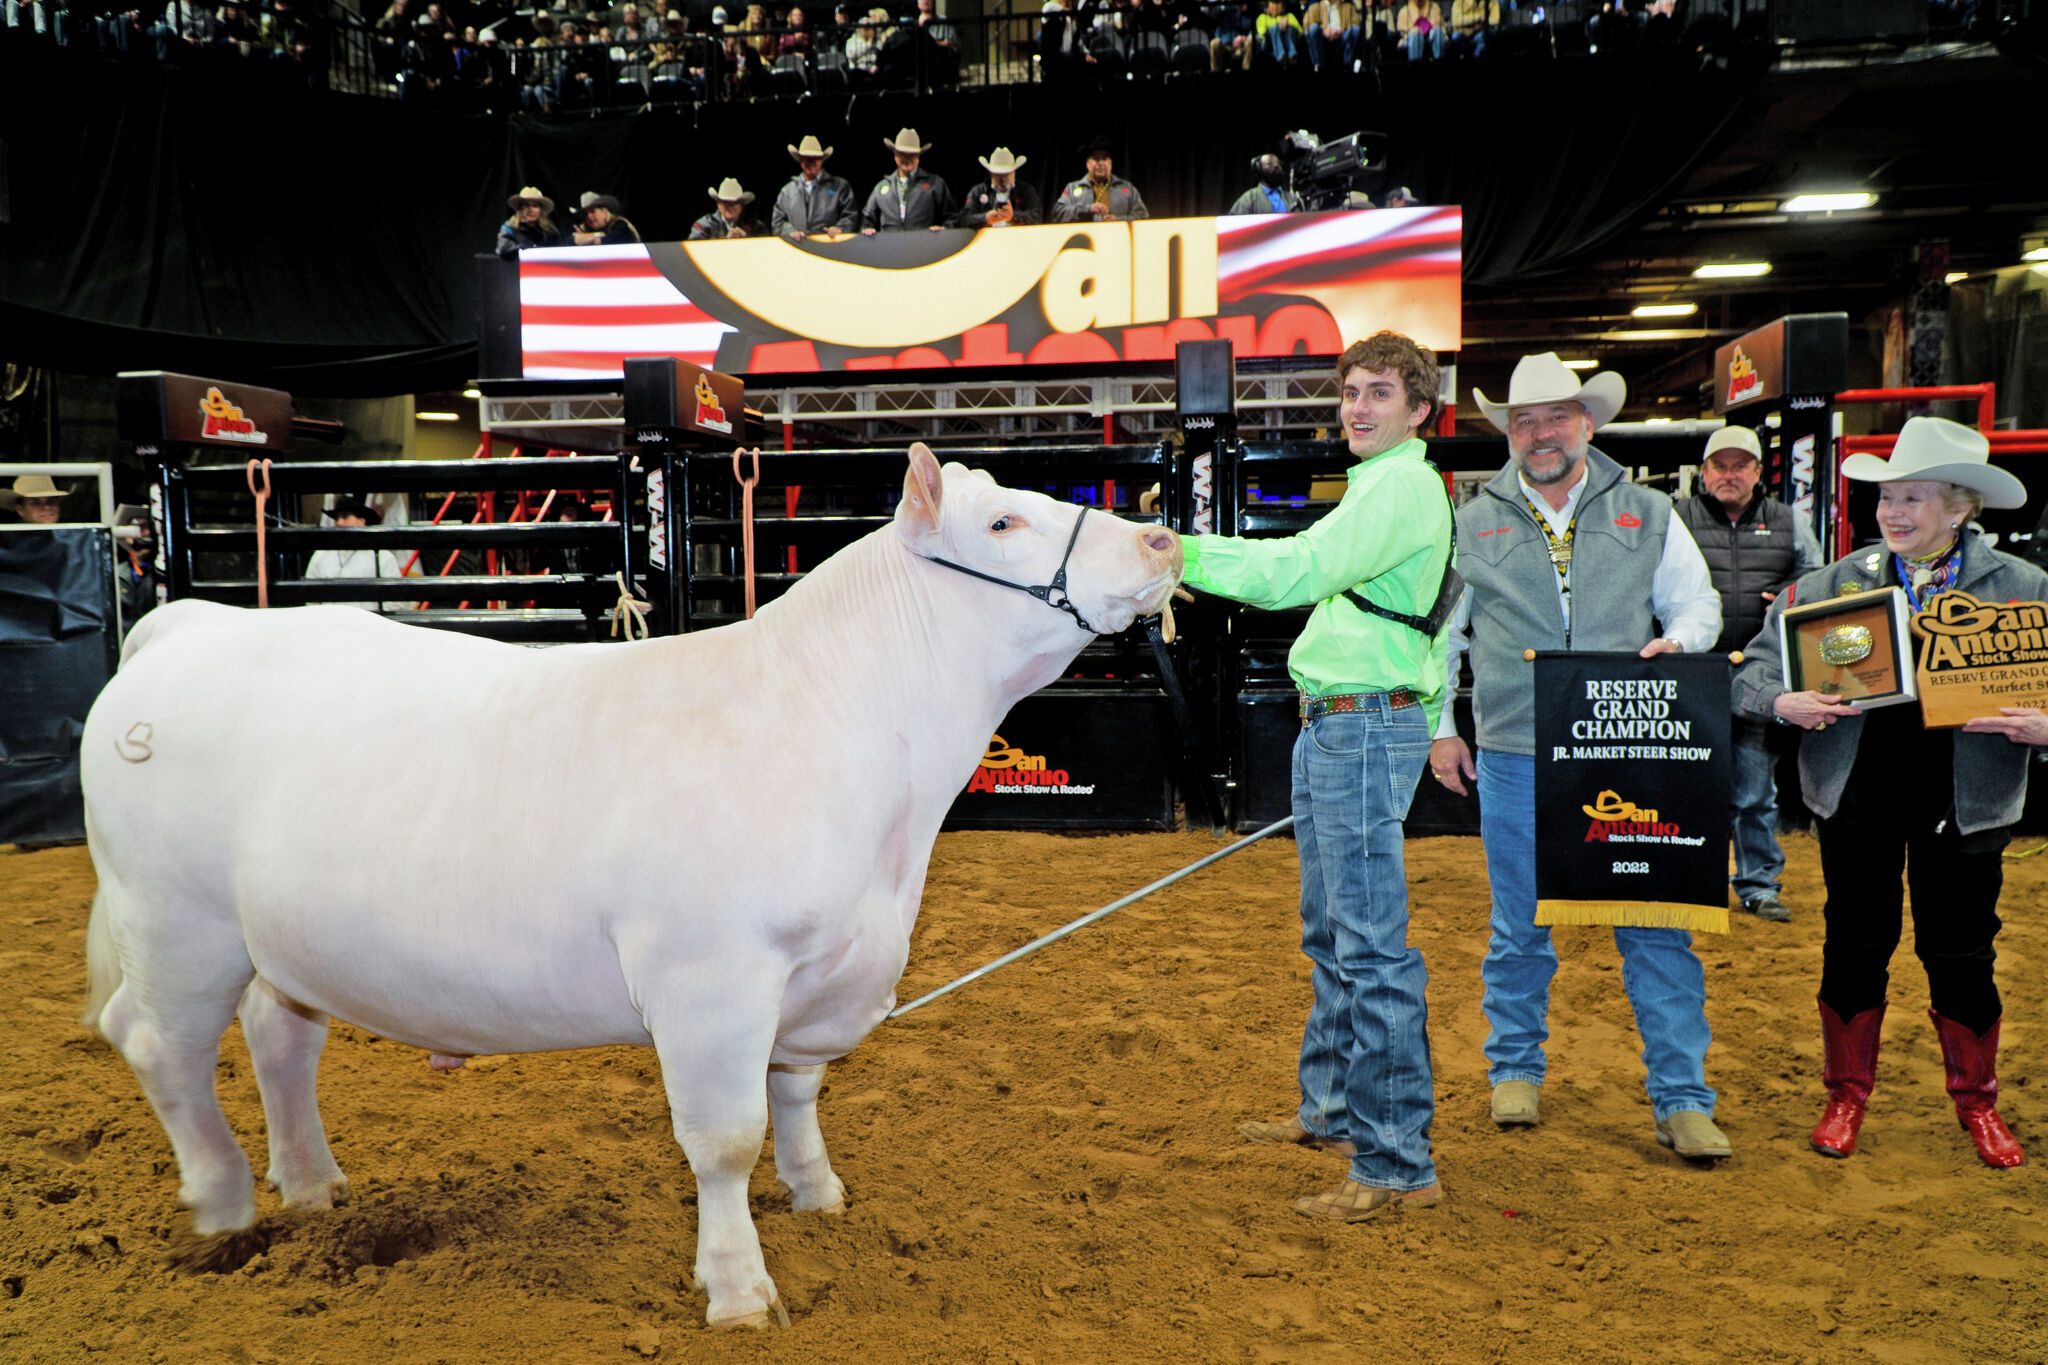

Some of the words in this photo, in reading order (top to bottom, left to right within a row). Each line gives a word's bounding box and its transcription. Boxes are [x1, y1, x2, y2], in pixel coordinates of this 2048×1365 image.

[1921, 597, 2046, 635] San
[1970, 653, 2009, 666] Stock
[1930, 670, 1988, 686] RESERVE
[1990, 667, 2039, 680] GRAND
[1586, 680, 1677, 700] RESERVE
[1981, 681, 2032, 695] Market
[1592, 700, 1670, 719] GRAND
[1571, 720, 1691, 740] CHAMPION
[979, 734, 1046, 771] San
[1552, 746, 1570, 761] JR.
[1573, 746, 1627, 759] MARKET
[1628, 746, 1668, 760] STEER
[1669, 748, 1712, 761] SHOW
[967, 766, 1069, 793] Antonio
[994, 784, 1022, 793] Stock
[1023, 784, 1050, 793] Show
[1051, 785, 1059, 794] &
[1582, 789, 1658, 823] San
[1584, 818, 1680, 842] Antonio
[1608, 834, 1635, 843] Stock
[1636, 835, 1661, 844] Show
[1662, 836, 1670, 844] &
[1612, 861, 1650, 874] 2022
